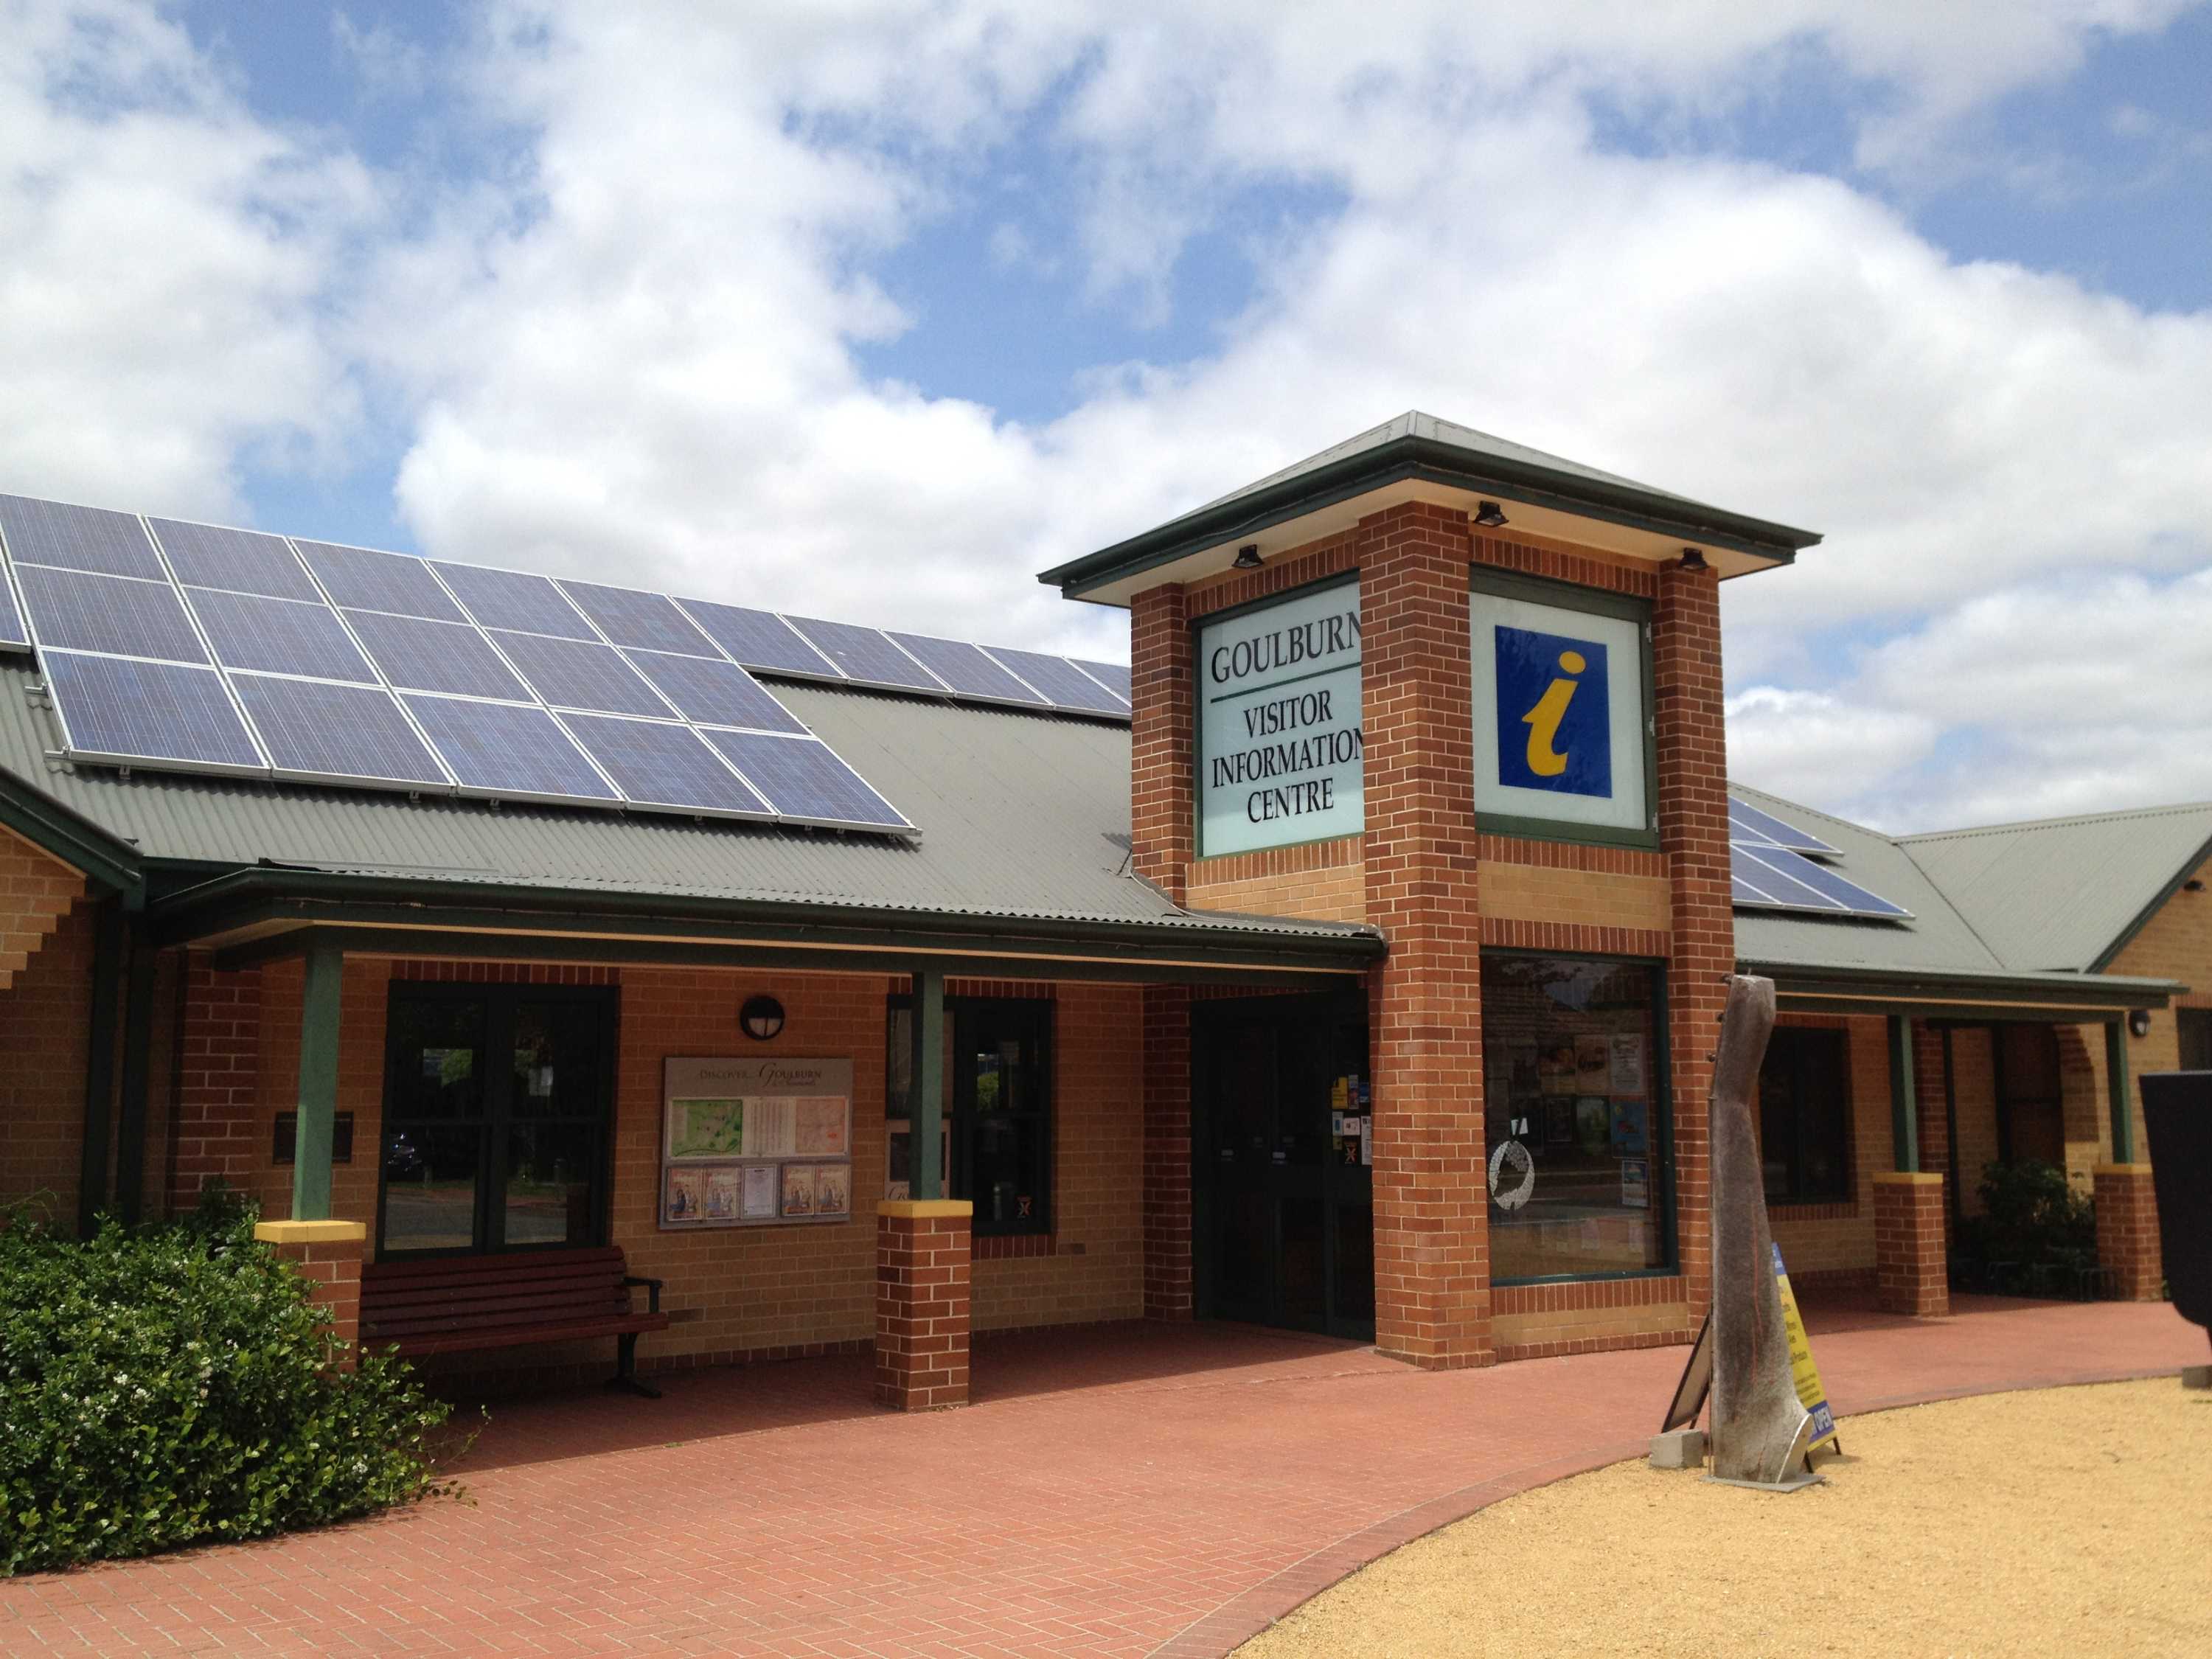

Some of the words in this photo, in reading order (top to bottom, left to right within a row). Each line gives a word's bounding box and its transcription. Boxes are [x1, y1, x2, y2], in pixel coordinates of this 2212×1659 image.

[1211, 611, 1362, 684] GOULBURN
[1244, 689, 1333, 738] VISITOR
[1211, 727, 1363, 788] INFORMATION
[1247, 777, 1334, 824] CENTRE
